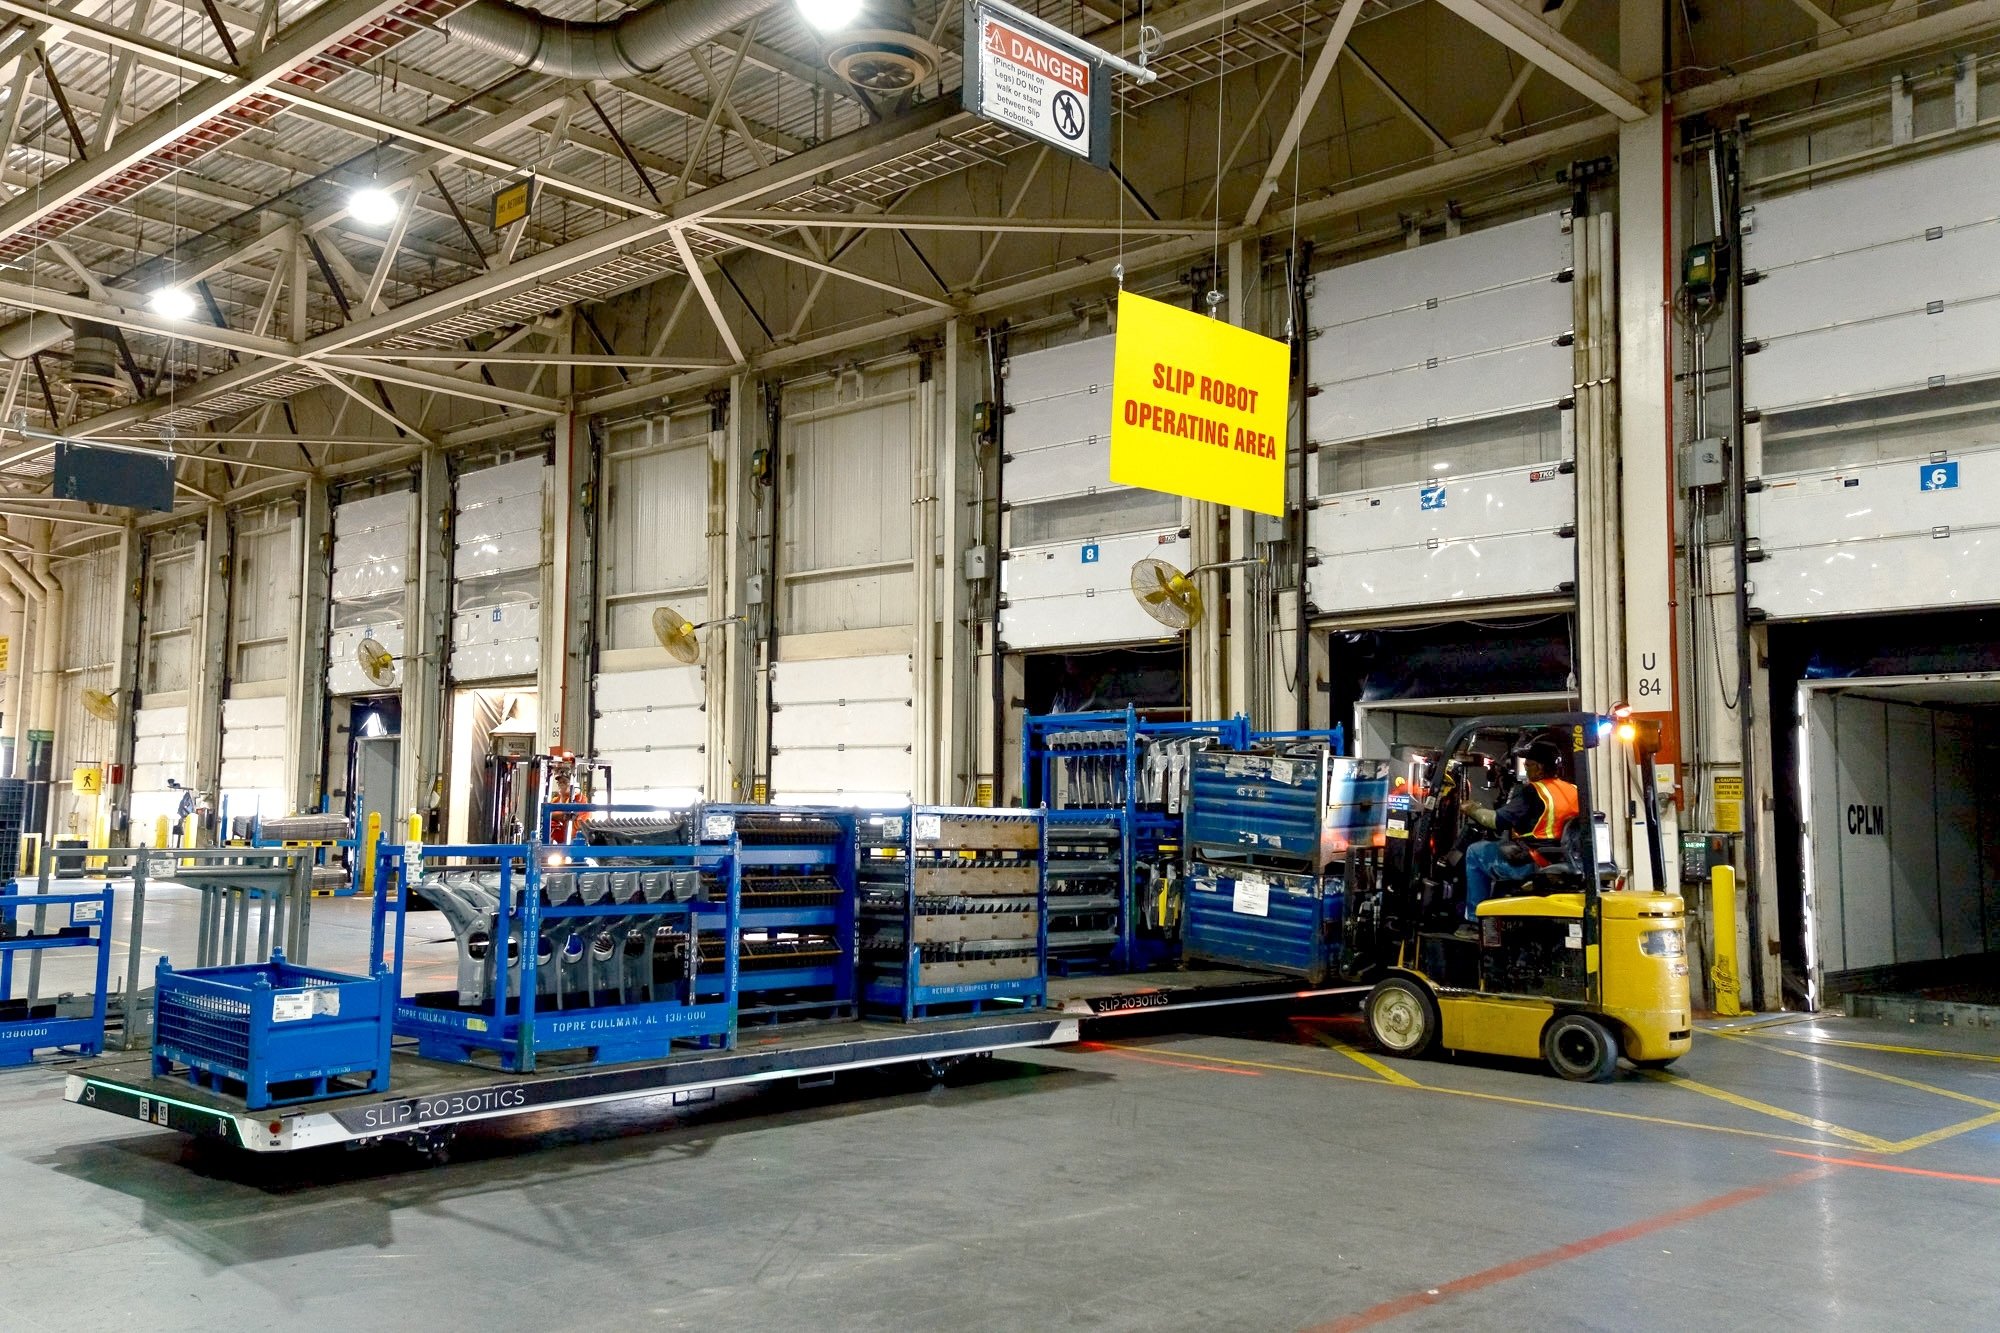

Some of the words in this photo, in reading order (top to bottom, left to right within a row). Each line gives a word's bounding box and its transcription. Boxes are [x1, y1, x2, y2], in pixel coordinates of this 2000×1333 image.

[993, 56, 1016, 74] (Pinch
[1017, 67, 1037, 81] point
[1036, 77, 1045, 86] on
[1011, 38, 1084, 89] DANGER
[994, 69, 1015, 86] Legs)
[1016, 77, 1027, 89] DO
[1028, 81, 1043, 96] NOT
[996, 82, 1012, 96] walk
[1013, 89, 1022, 98] or
[1022, 91, 1042, 107] stand
[997, 94, 1026, 112] between
[1027, 105, 1041, 119] Slip
[1003, 108, 1034, 127] Robotics
[1153, 362, 1195, 395] SLIP
[1200, 375, 1259, 414] ROBOT
[1124, 399, 1229, 448] OPERATING
[1234, 427, 1277, 460] AREA
[1540, 470, 1554, 478] TKO
[1931, 468, 1947, 485] 6
[1086, 548, 1095, 561] 8
[1642, 652, 1656, 671] U
[1639, 678, 1662, 697] 84
[553, 713, 560, 723] U
[552, 726, 560, 738] 85
[1573, 724, 1584, 752] Yale
[1235, 787, 1246, 797] 45
[1847, 804, 1884, 836] CPLM
[1099, 1000, 1120, 1011] SLIP
[1122, 994, 1168, 1009] ROBOTICS
[552, 1020, 586, 1033] TOPRE
[645, 1015, 658, 1025] AL
[365, 1105, 412, 1128] SLIP
[419, 1088, 525, 1120] ROBOTICS
[218, 1117, 227, 1137] 76
